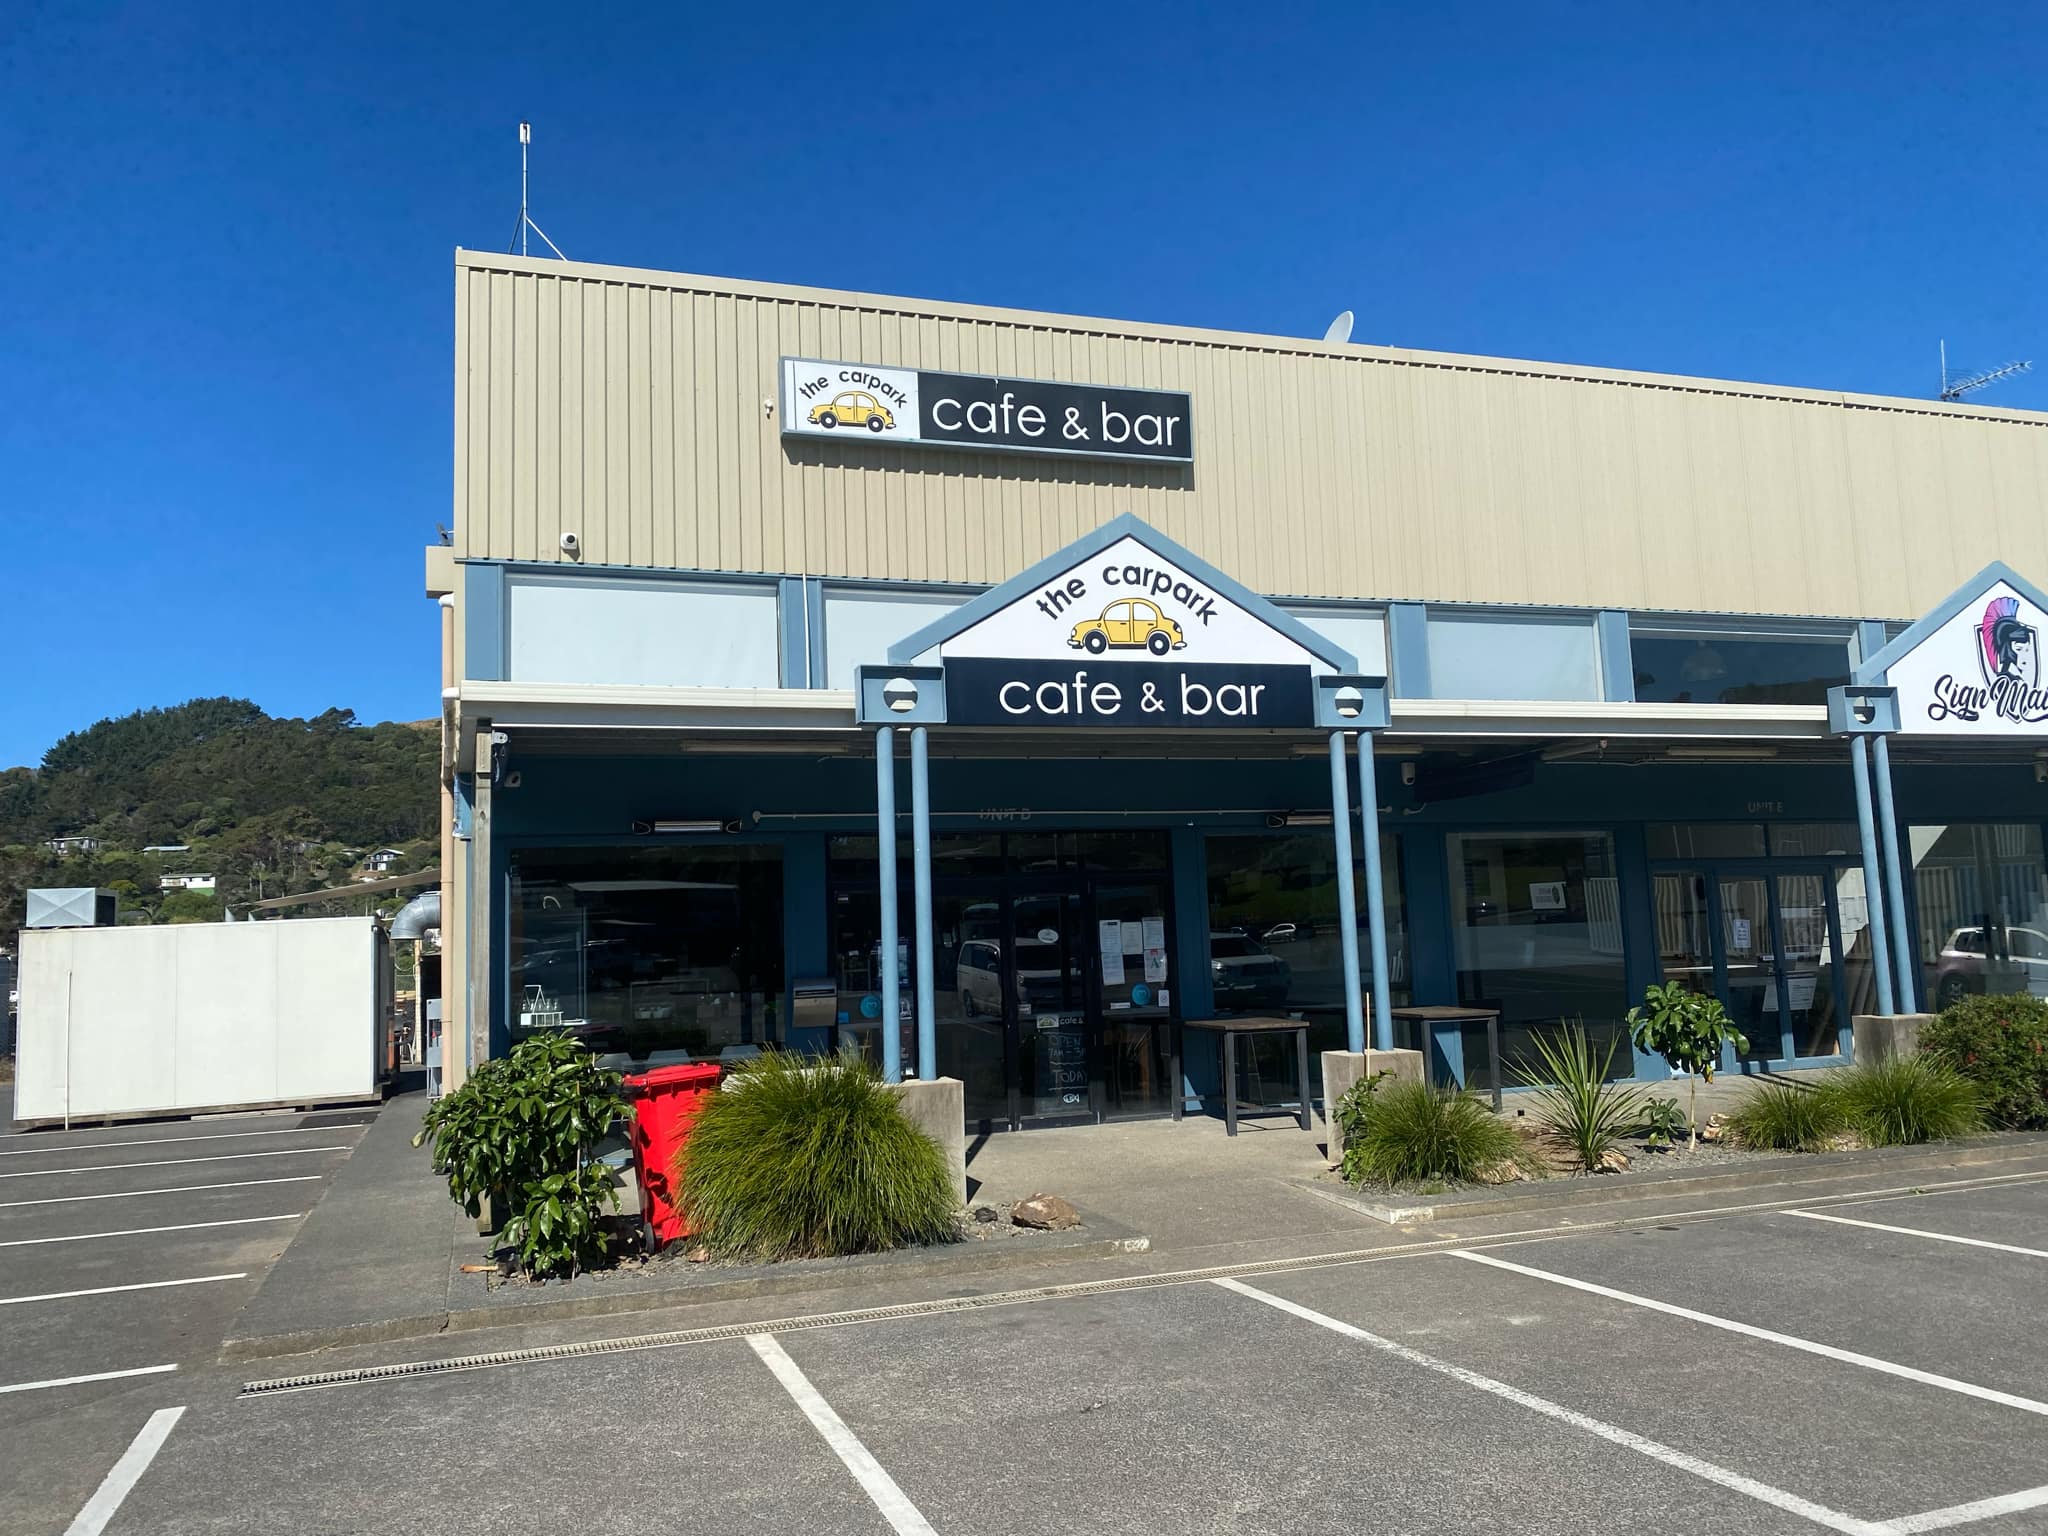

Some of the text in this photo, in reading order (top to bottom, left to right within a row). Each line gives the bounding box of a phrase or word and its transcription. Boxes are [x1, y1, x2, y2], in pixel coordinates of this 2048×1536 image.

[799, 371, 908, 408] the carpark
[932, 393, 1180, 446] cafe & bar
[1035, 565, 1219, 626] the carpark
[999, 671, 1266, 716] cafe & bar
[1928, 674, 1989, 721] Sign
